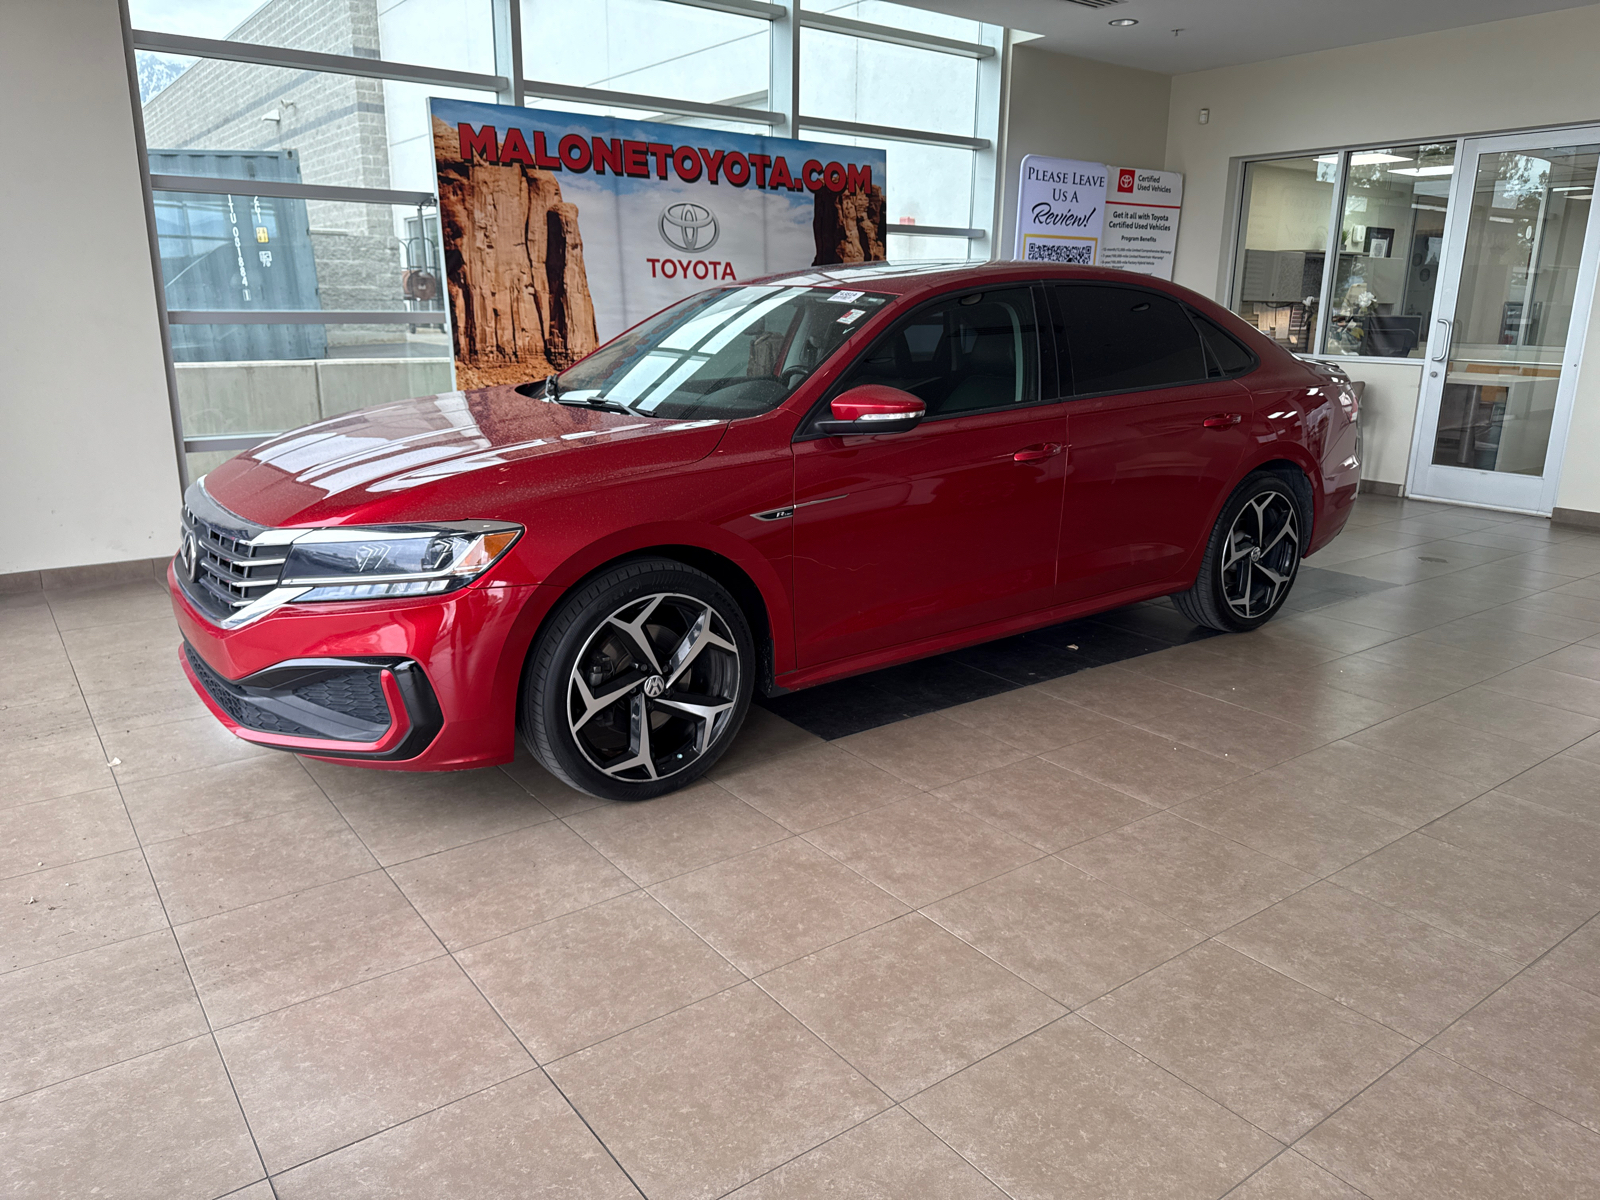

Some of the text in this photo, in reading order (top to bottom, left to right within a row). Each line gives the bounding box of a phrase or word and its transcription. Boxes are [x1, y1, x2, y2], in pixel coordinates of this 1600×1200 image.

[458, 122, 872, 196] MALONETOYOTA.COM
[1028, 166, 1105, 187] PLEASE LEAVE
[1138, 175, 1160, 183] Certified
[1052, 188, 1079, 203] US A
[1137, 183, 1172, 193] Used Vehicles
[1031, 202, 1096, 227] Review!
[1113, 211, 1169, 222] Get it all with Toyota
[1109, 221, 1171, 231] Certified Used Vehicles
[647, 258, 737, 281] TOYOTA
